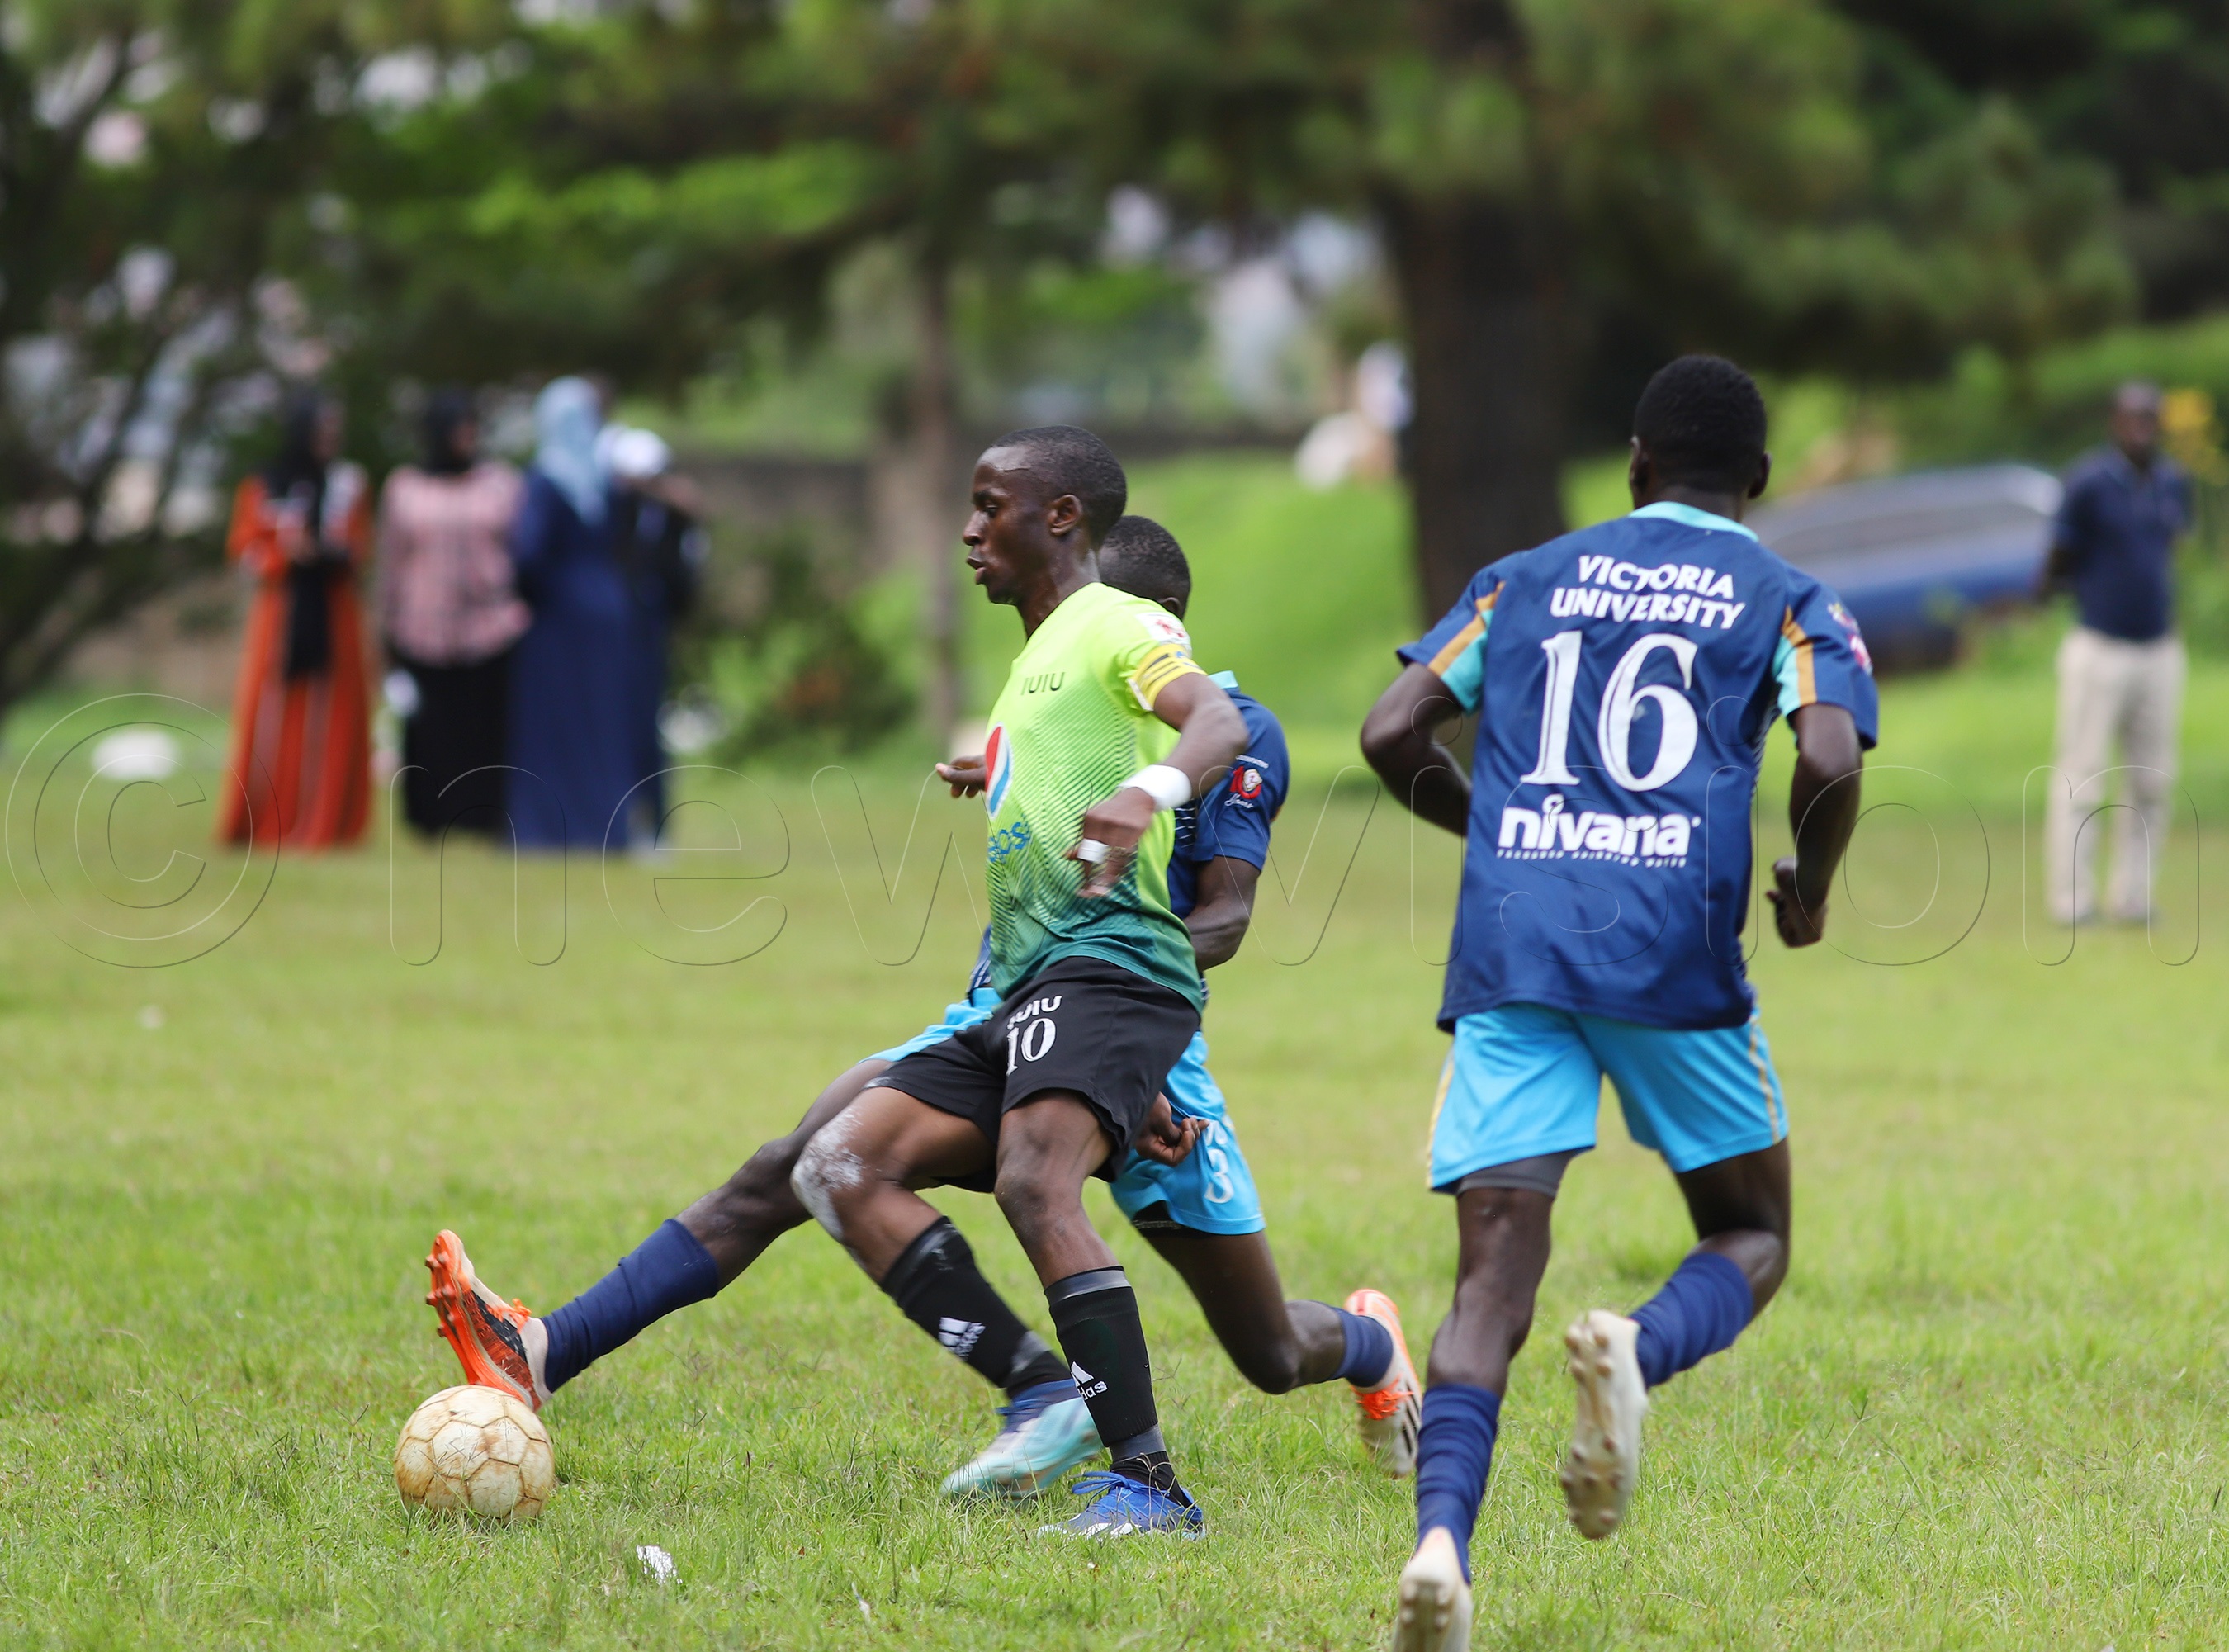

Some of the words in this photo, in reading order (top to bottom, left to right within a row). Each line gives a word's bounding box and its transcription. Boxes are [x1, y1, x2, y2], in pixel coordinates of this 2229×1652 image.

[1578, 555, 1734, 599] VICTORIA
[1550, 586, 1747, 629] UNIVERSITY
[1520, 630, 1699, 792] 16
[1498, 793, 1692, 857] nivana
[1005, 1017, 1057, 1077] 10
